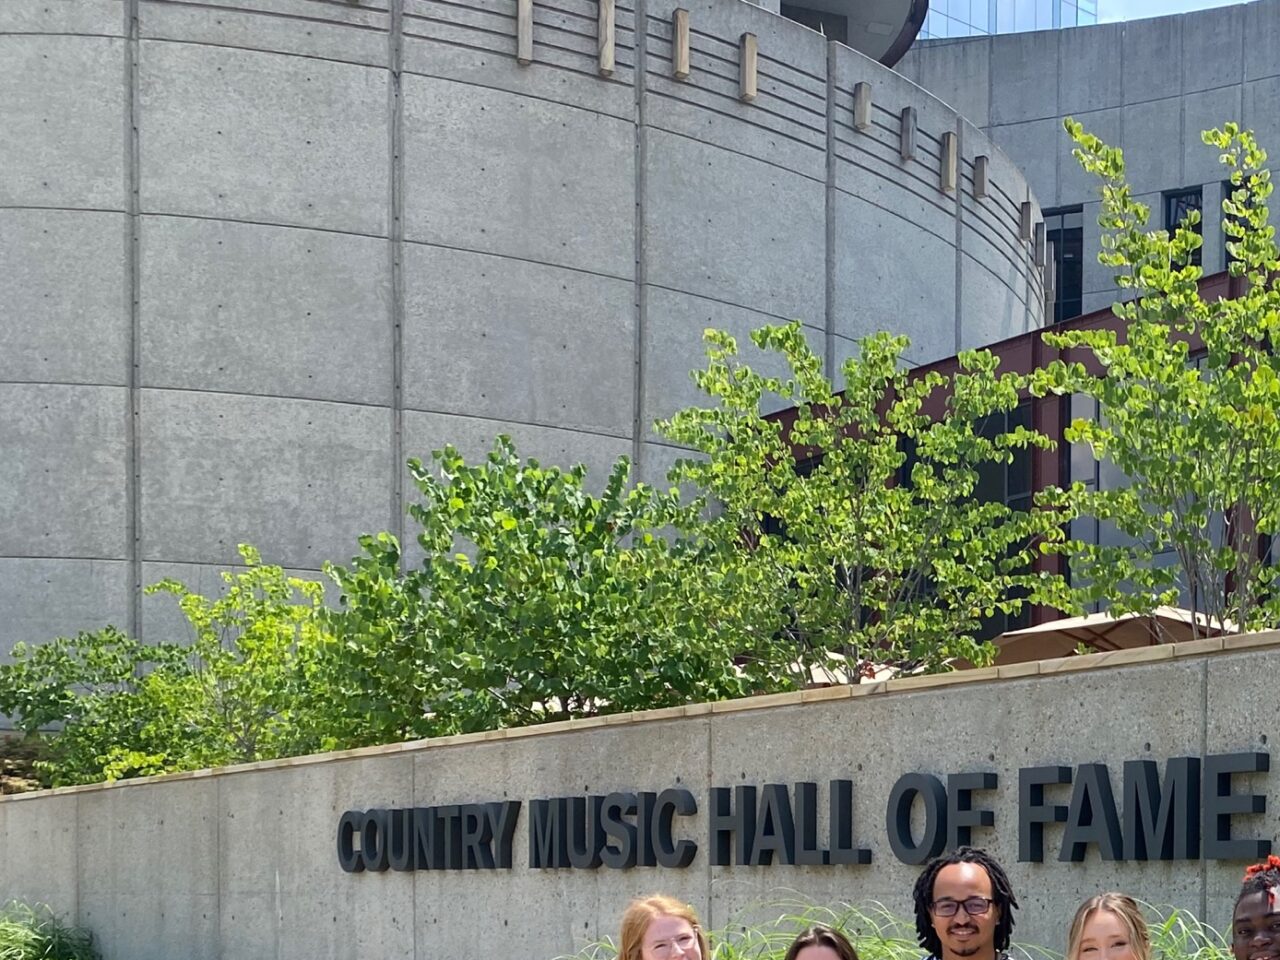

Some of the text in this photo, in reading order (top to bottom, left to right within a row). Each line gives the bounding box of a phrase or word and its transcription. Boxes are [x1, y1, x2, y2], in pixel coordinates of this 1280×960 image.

[337, 801, 521, 873] COUNTRY
[528, 788, 698, 869] MUSIC
[709, 779, 872, 866] HALL
[886, 772, 998, 866] OF
[1018, 752, 1272, 863] FAME
